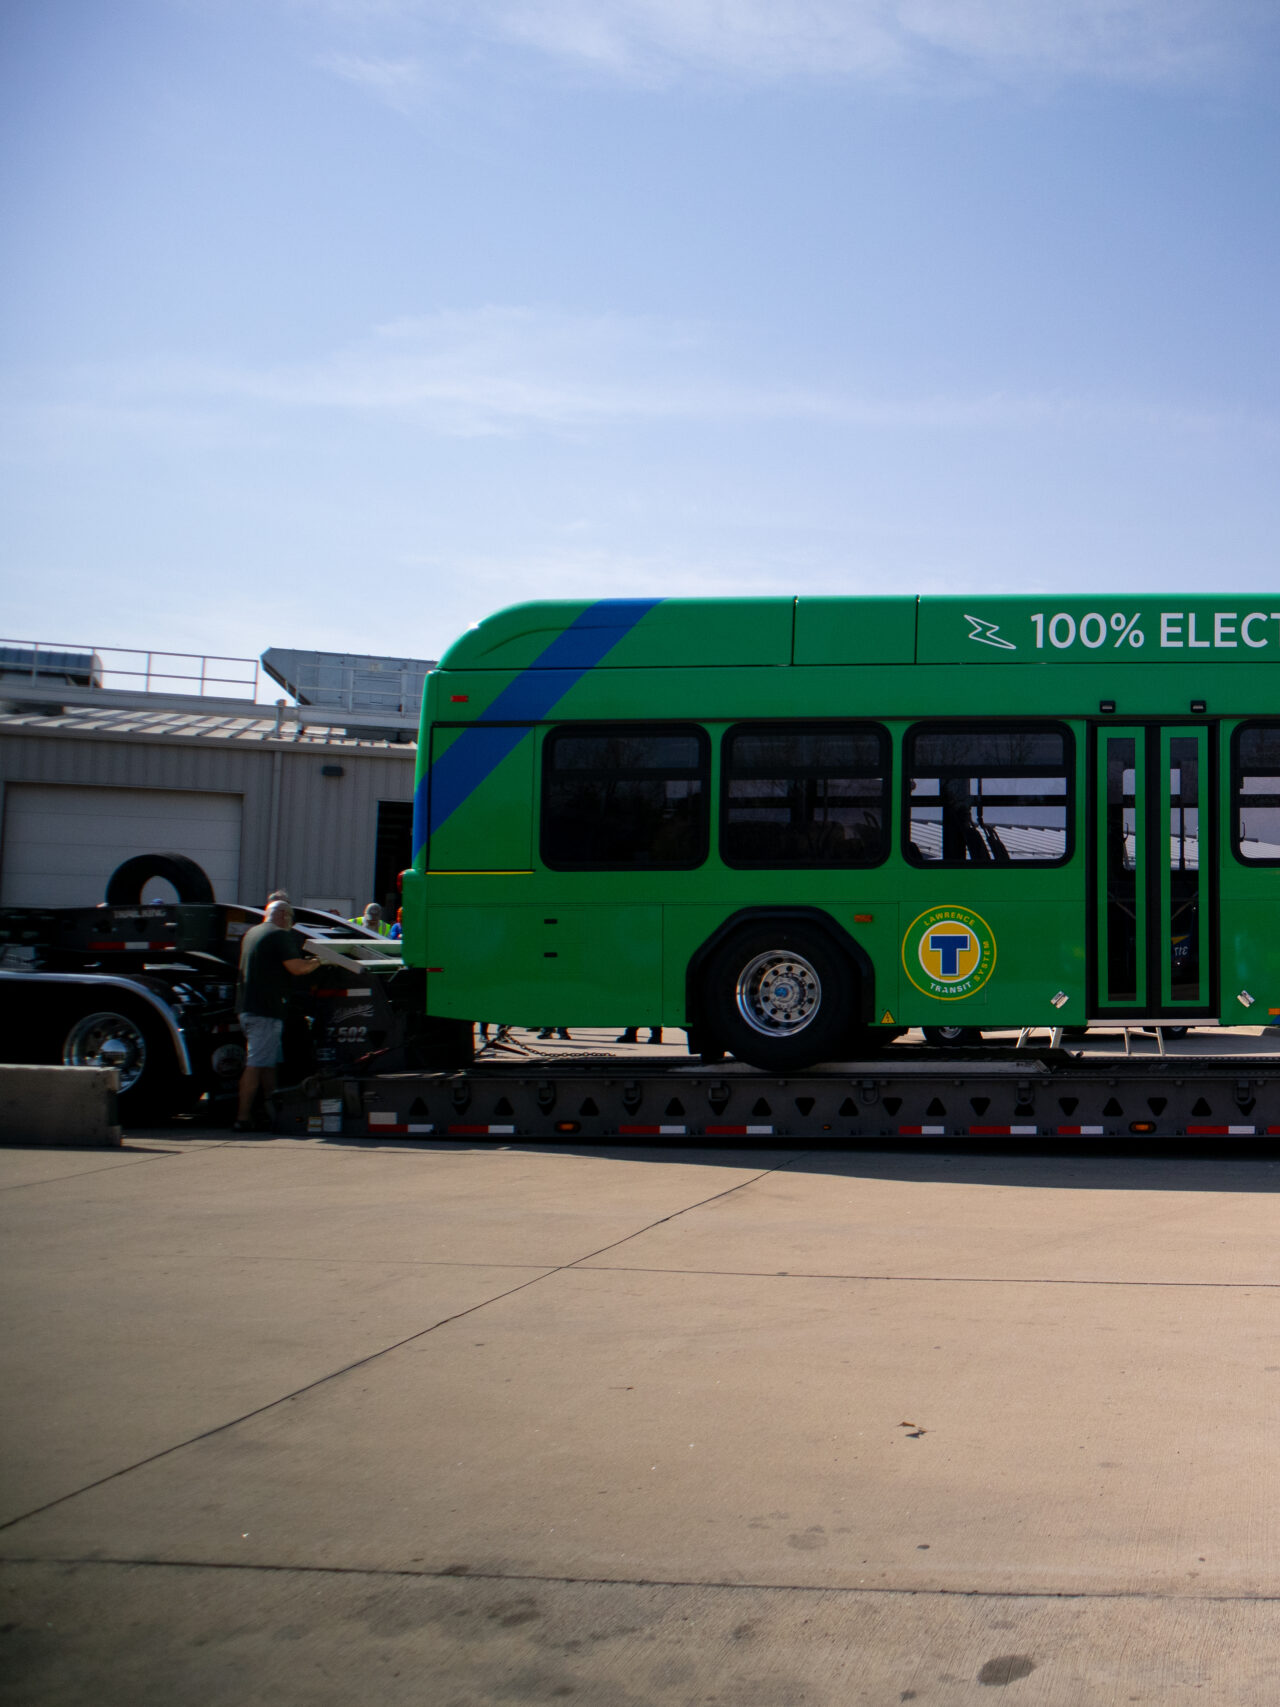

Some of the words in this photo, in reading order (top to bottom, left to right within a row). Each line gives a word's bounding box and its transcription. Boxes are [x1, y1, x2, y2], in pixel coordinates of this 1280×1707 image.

[1030, 612, 1145, 649] 100%
[923, 911, 976, 927] LAWRENCE
[929, 934, 970, 977] T
[973, 940, 991, 982] SYSTEM
[930, 981, 972, 994] TRANSIT
